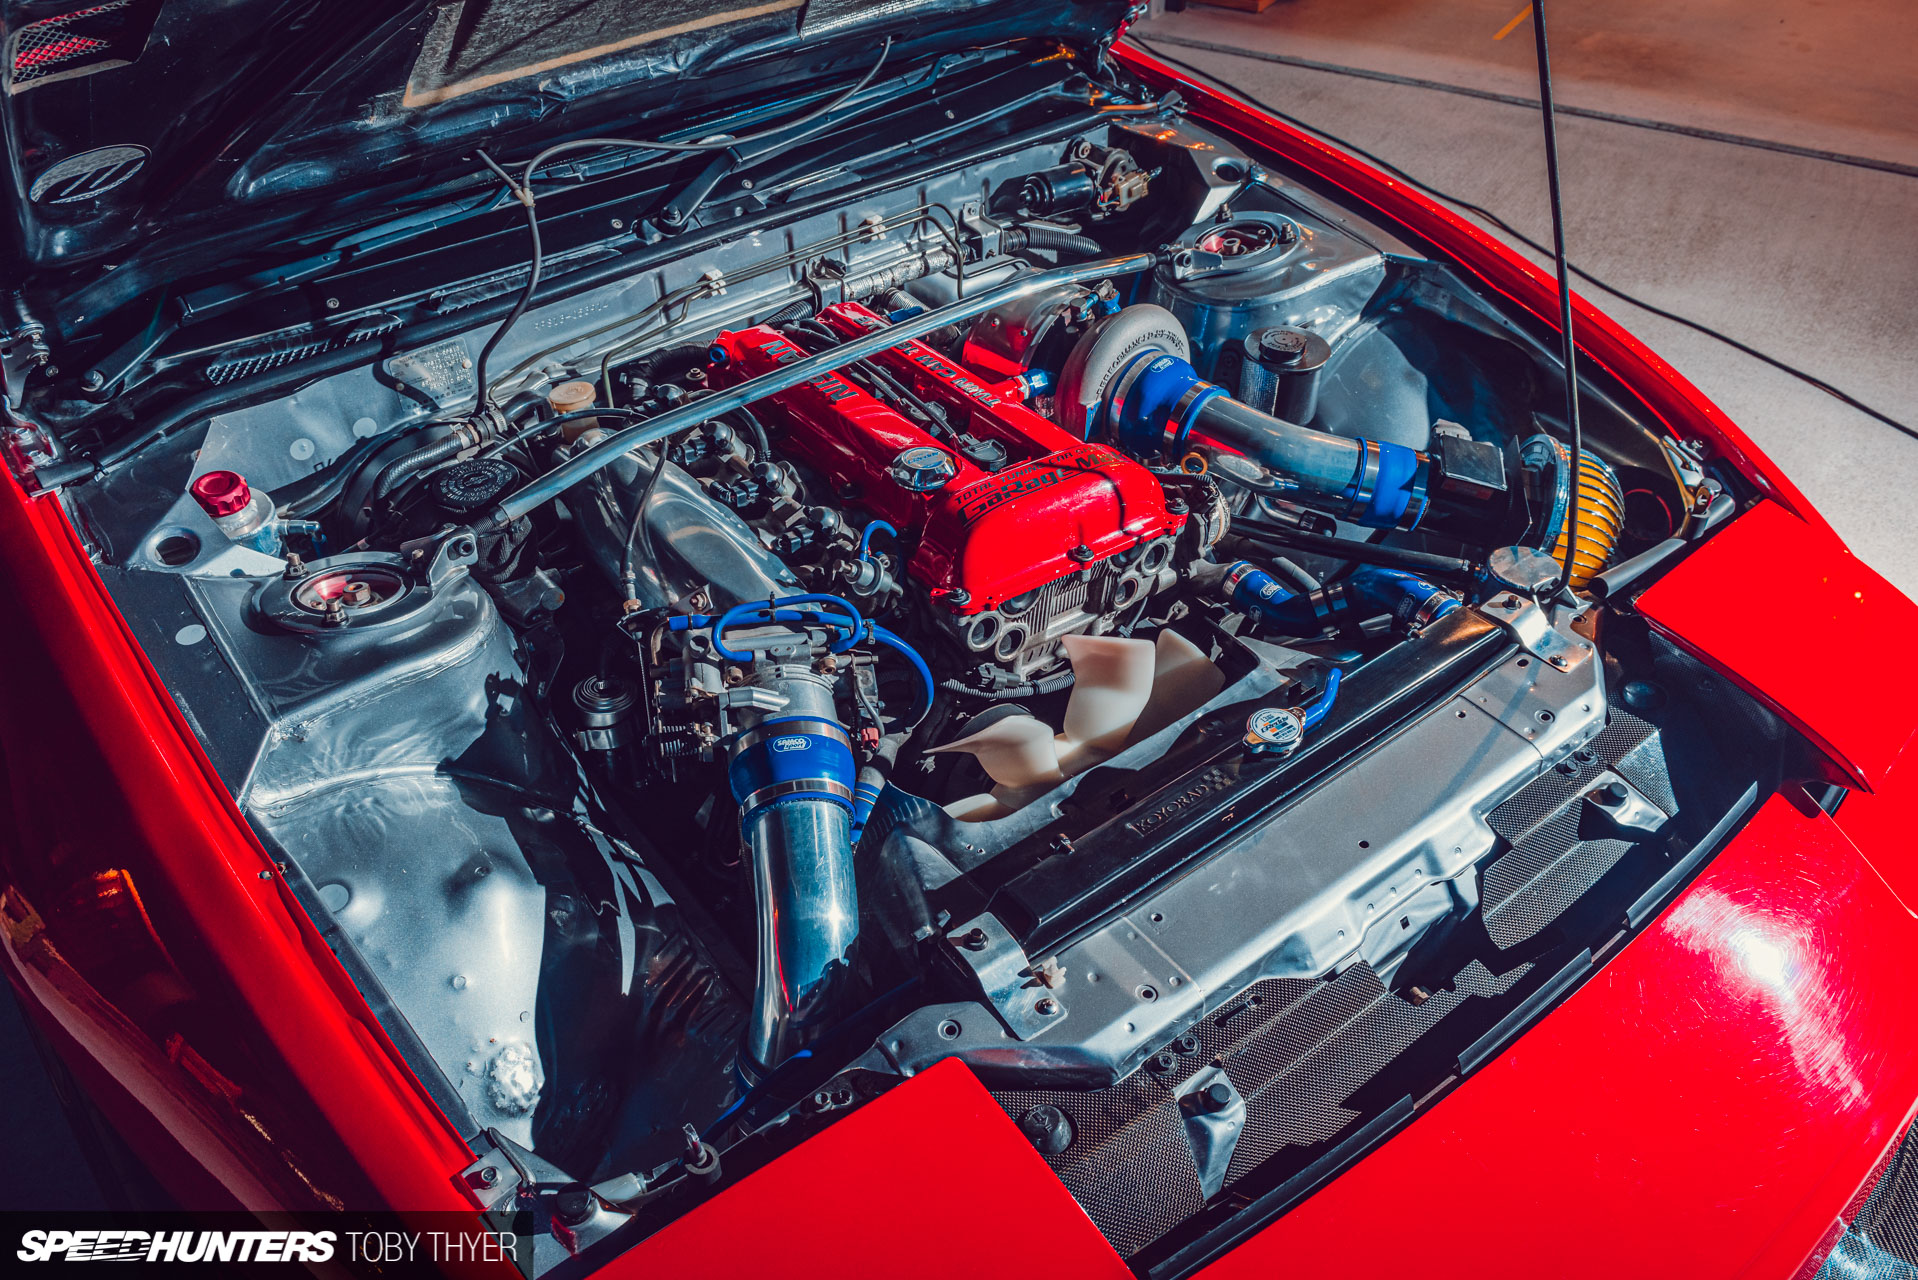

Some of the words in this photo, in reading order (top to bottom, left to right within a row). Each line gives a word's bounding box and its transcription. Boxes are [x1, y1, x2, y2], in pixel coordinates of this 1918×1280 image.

[760, 340, 860, 401] NISAN
[915, 354, 958, 378] CAM
[951, 377, 1002, 408] TWIN
[955, 482, 996, 505] TOTAL
[1048, 452, 1074, 465] CAR
[1136, 784, 1210, 831] KOYORAD
